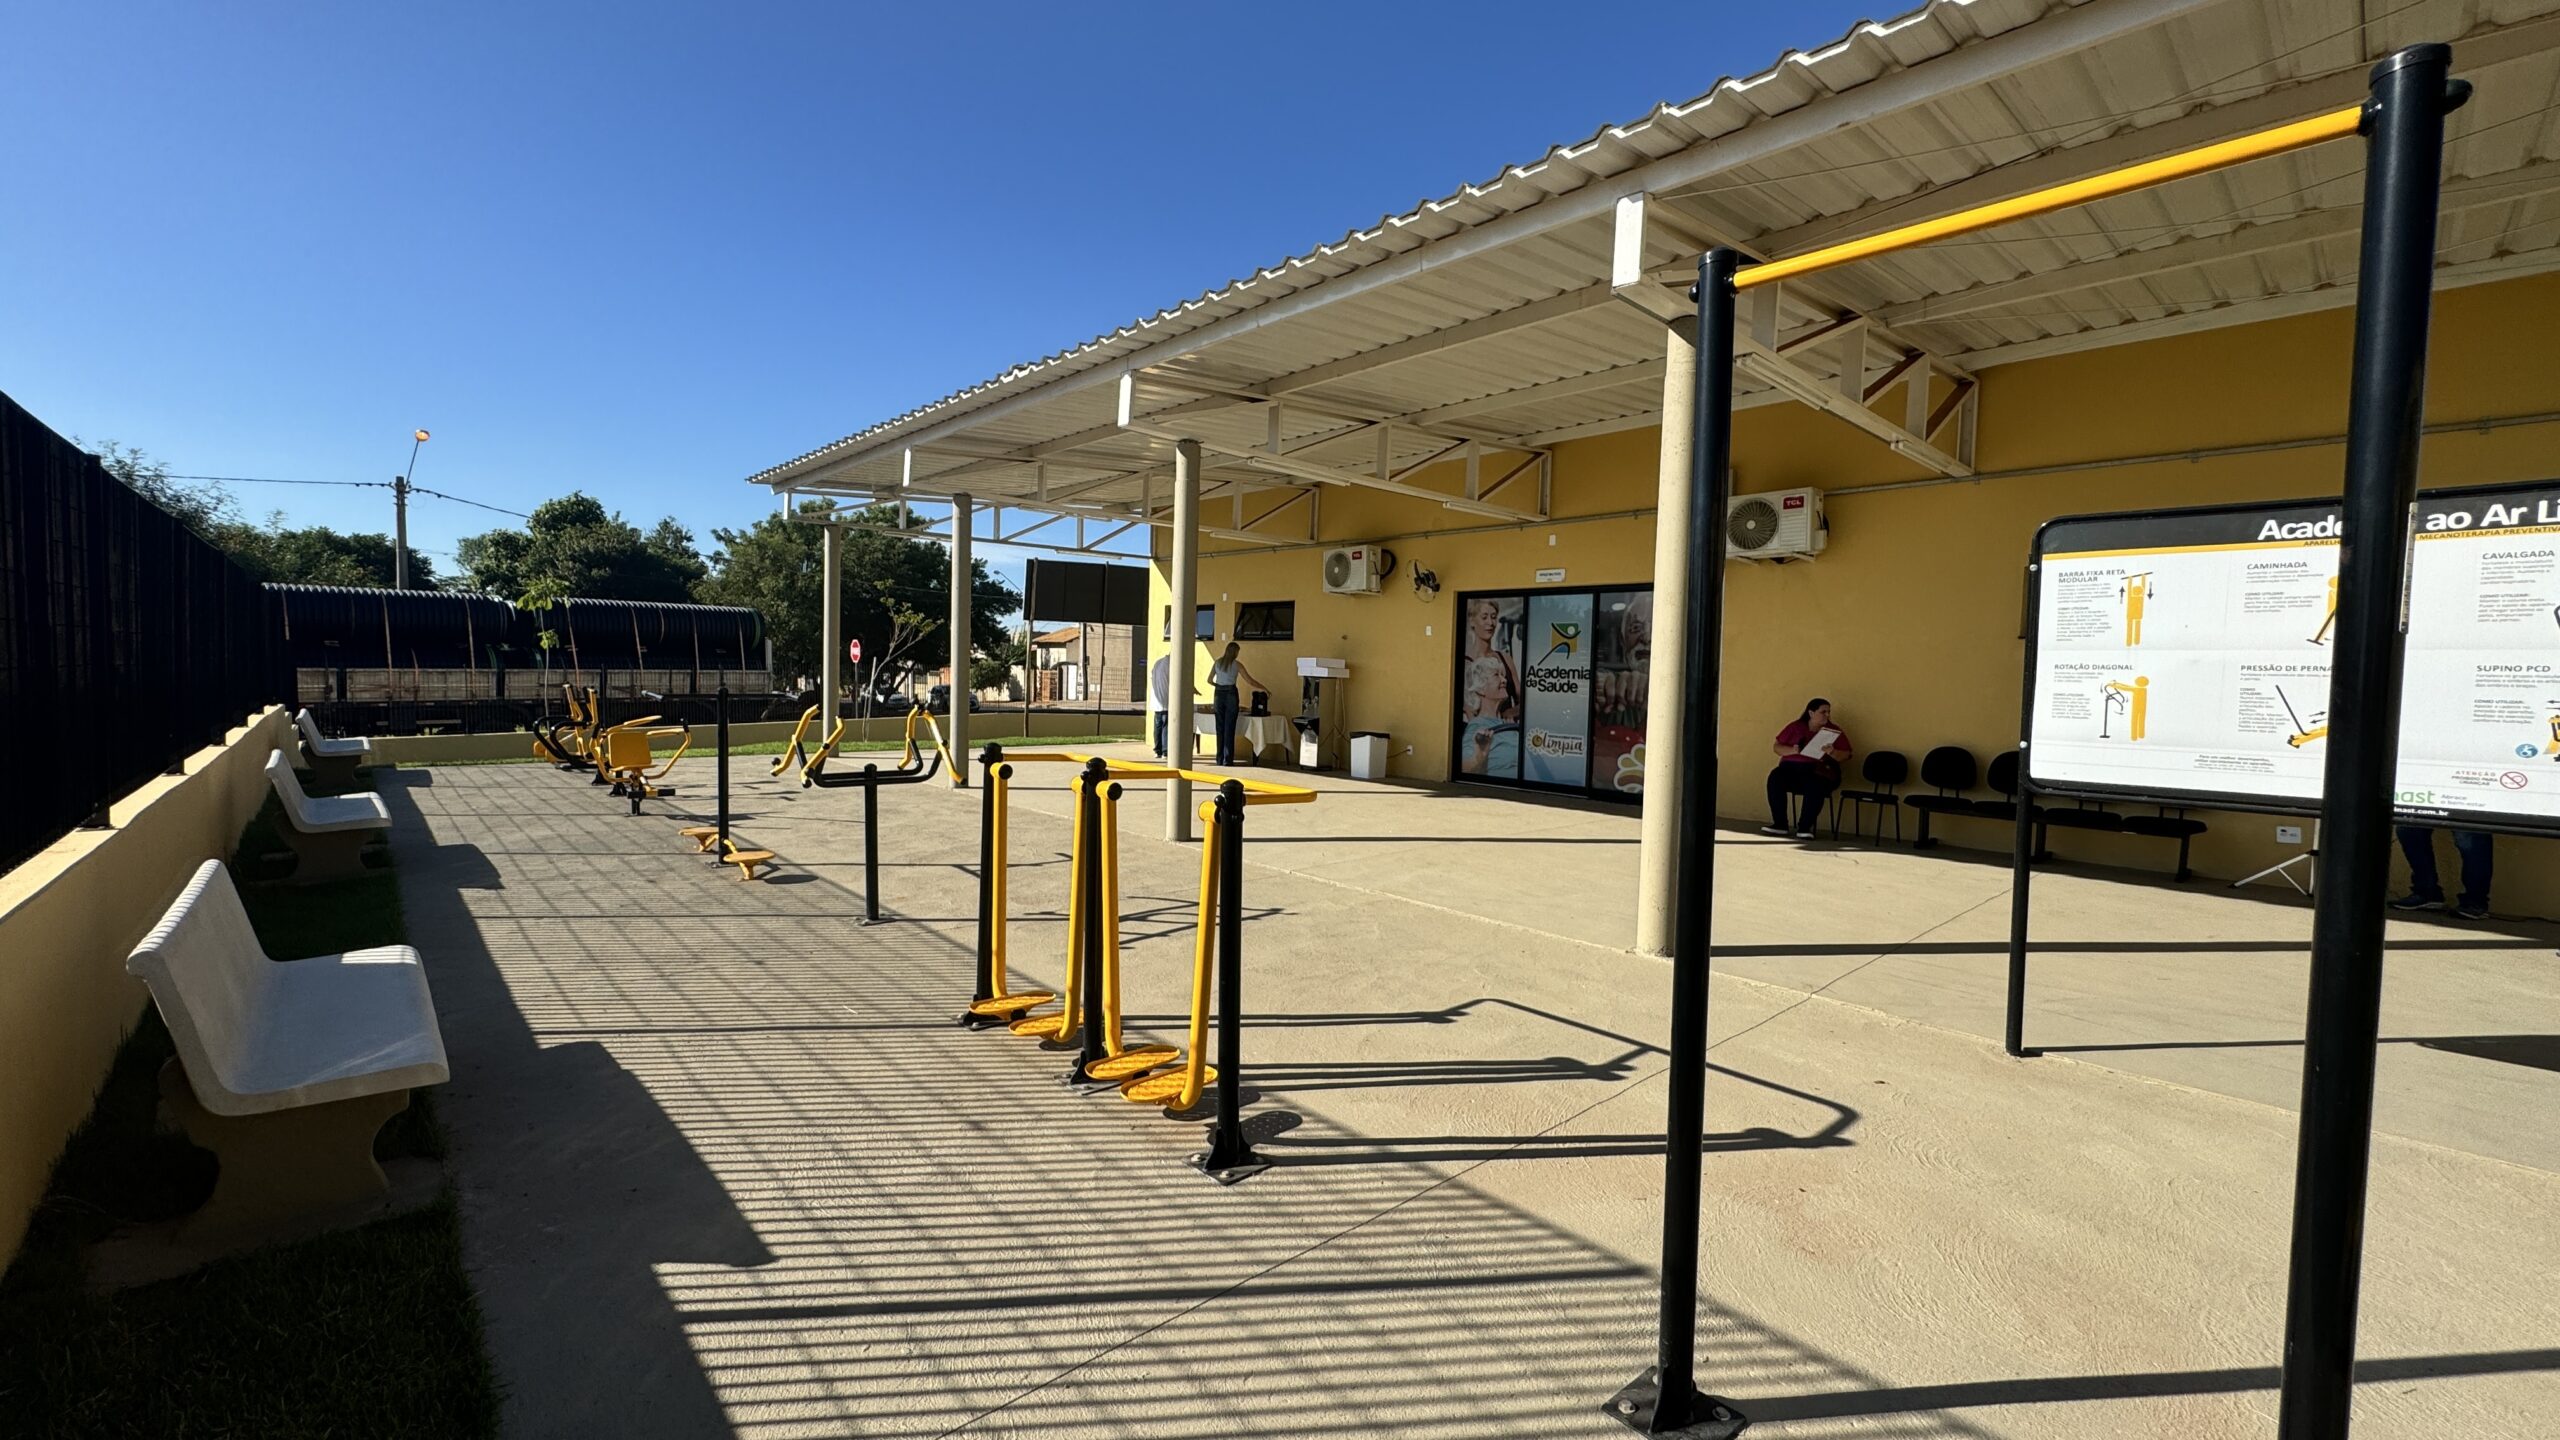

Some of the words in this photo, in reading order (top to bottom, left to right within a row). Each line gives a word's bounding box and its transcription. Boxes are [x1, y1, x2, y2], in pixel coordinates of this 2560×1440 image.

[2425, 511, 2472, 531] ao
[2480, 503, 2528, 527] Ar
[2420, 530, 2500, 540] MECANOTERAPIA
[2482, 550, 2555, 560] CAVALGADA
[2246, 561, 2308, 570] CAMINHADA
[2058, 576, 2098, 584] MODULAR
[2054, 663, 2090, 671] ROTAÇÃO
[2240, 663, 2283, 672] PRESSÃO
[2476, 664, 2523, 673] SUPINO
[2526, 665, 2551, 673] PCD
[1527, 665, 1591, 680] Academia
[1525, 678, 1538, 688] da
[1538, 678, 1578, 693] Saúde
